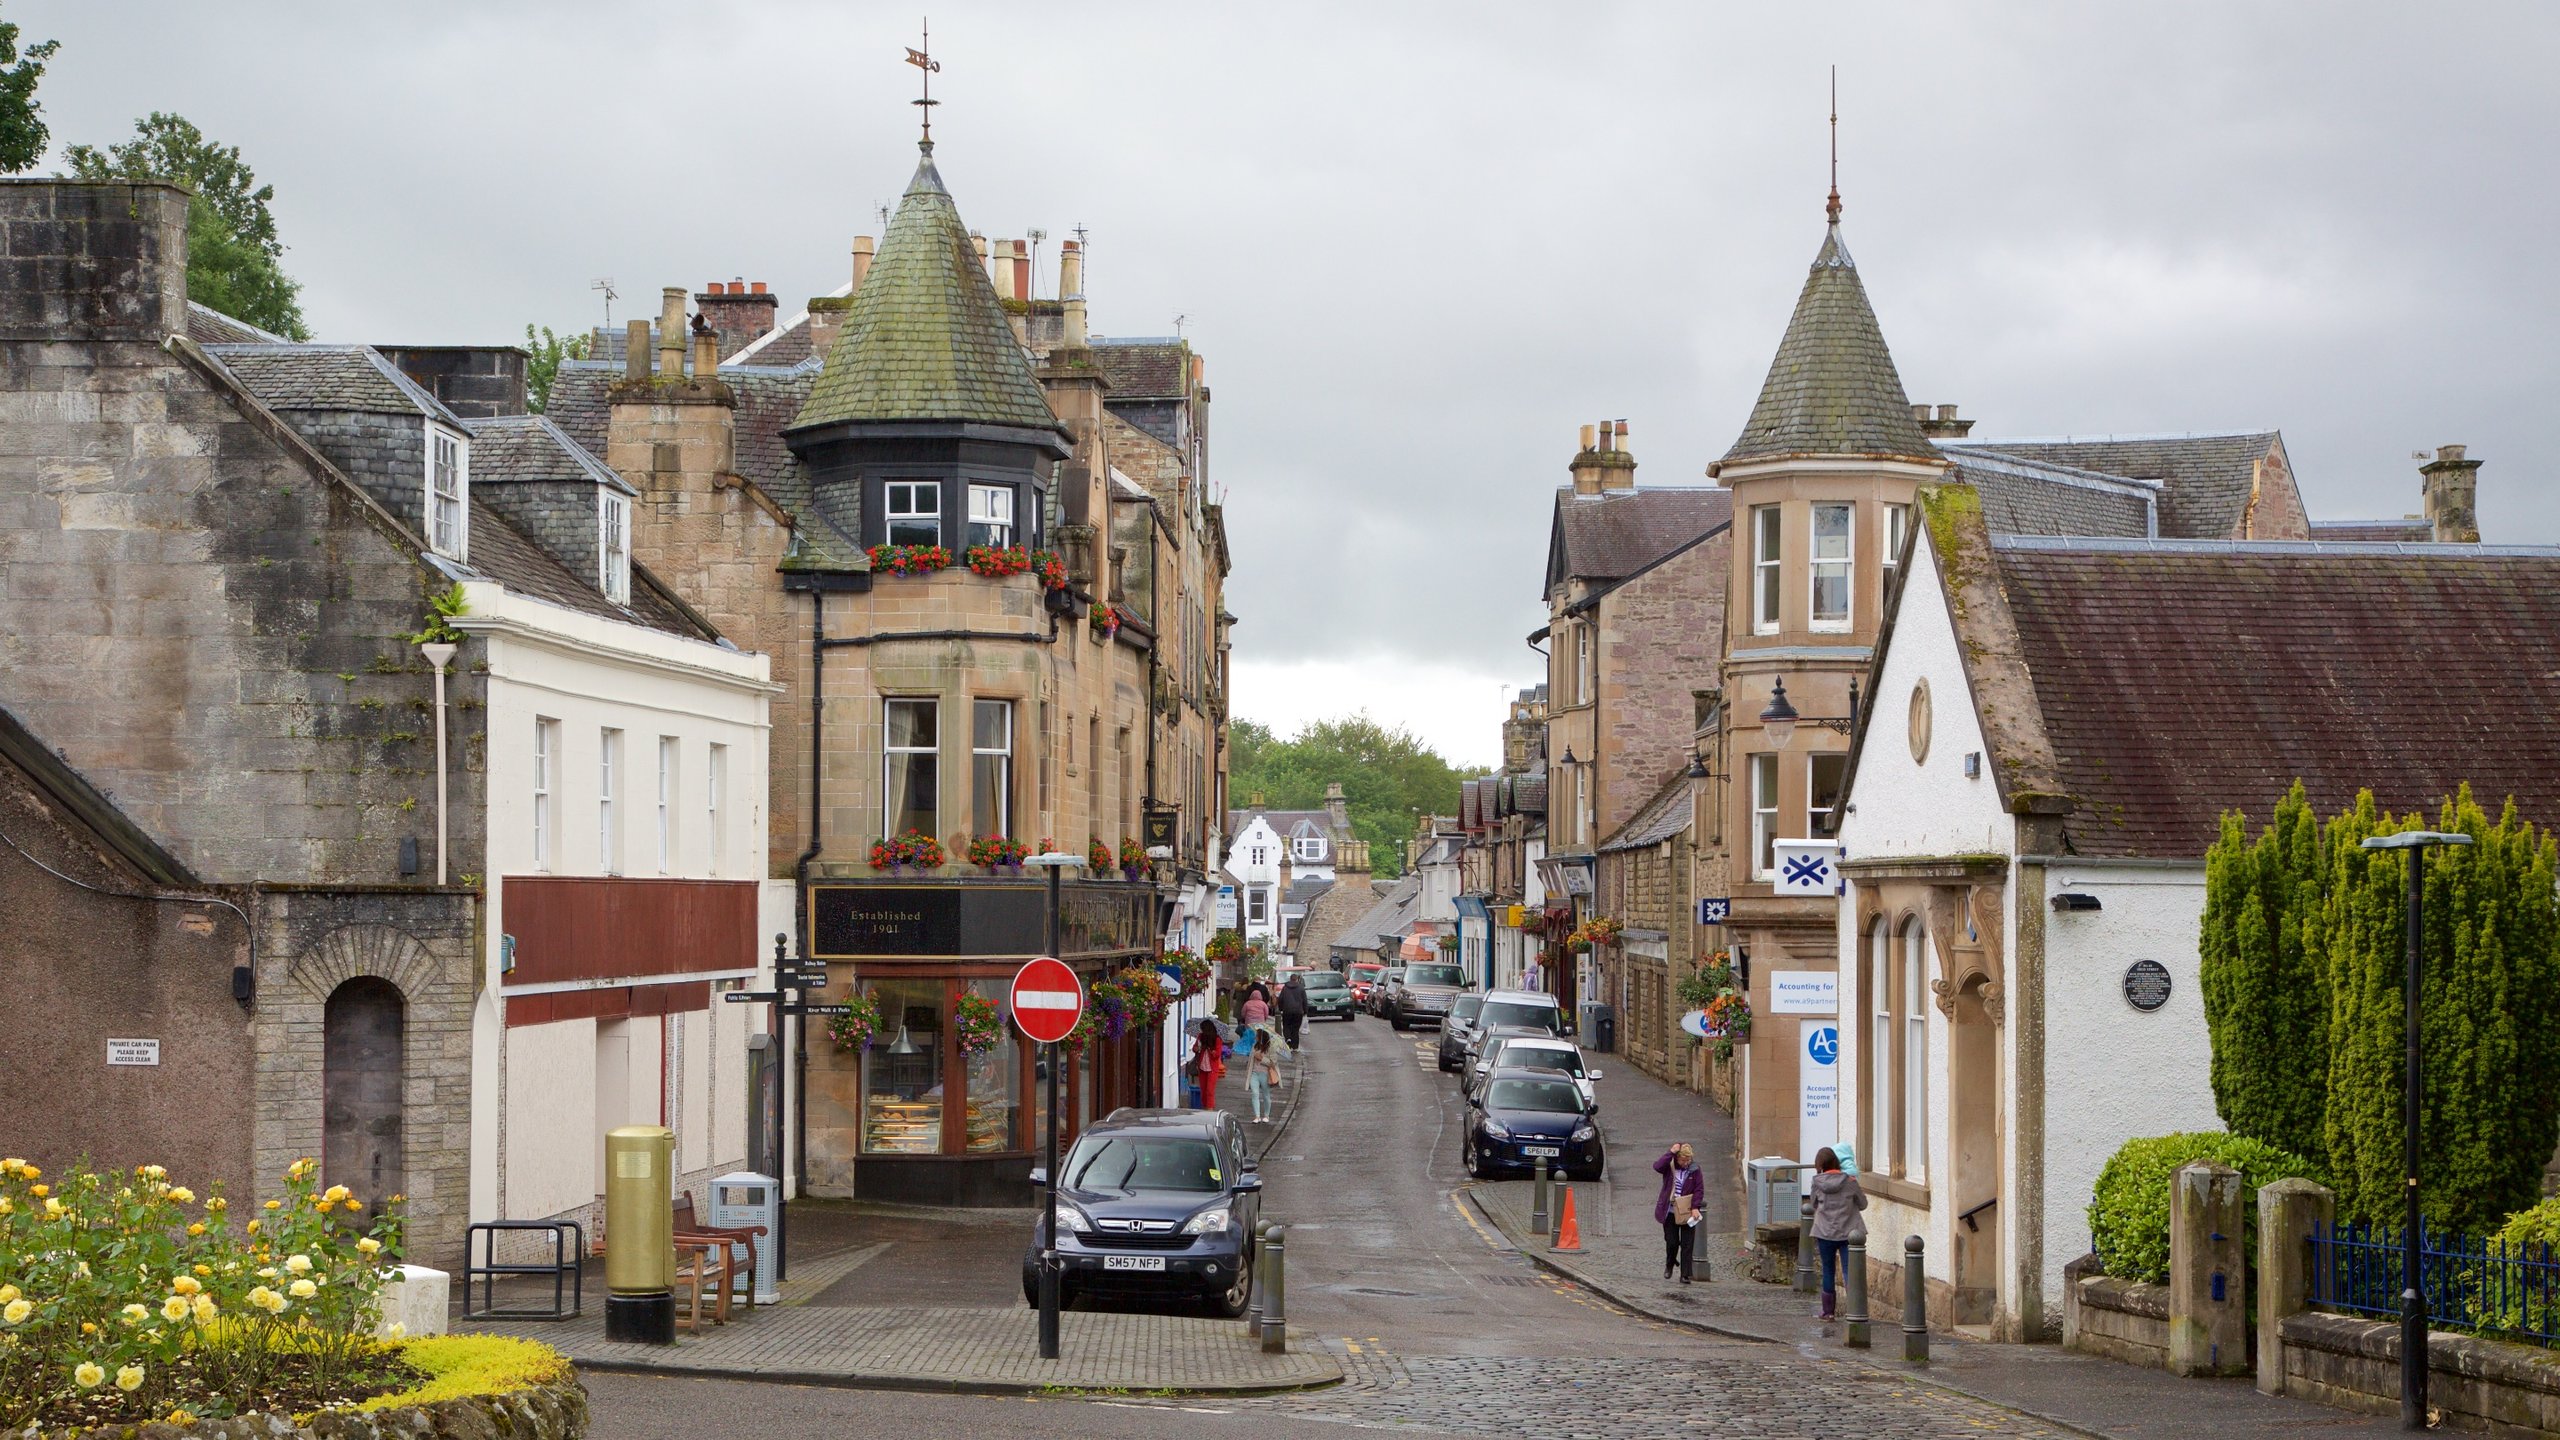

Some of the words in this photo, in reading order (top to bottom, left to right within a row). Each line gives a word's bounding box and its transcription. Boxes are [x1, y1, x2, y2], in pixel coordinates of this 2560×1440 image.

[851, 911, 921, 920] Established
[873, 925, 898, 933] 1901
[1779, 983, 1820, 991] Accounting
[1807, 1102, 1830, 1110] Payroll
[1108, 1257, 1136, 1268] SM57
[1139, 1258, 1161, 1268] NFP
